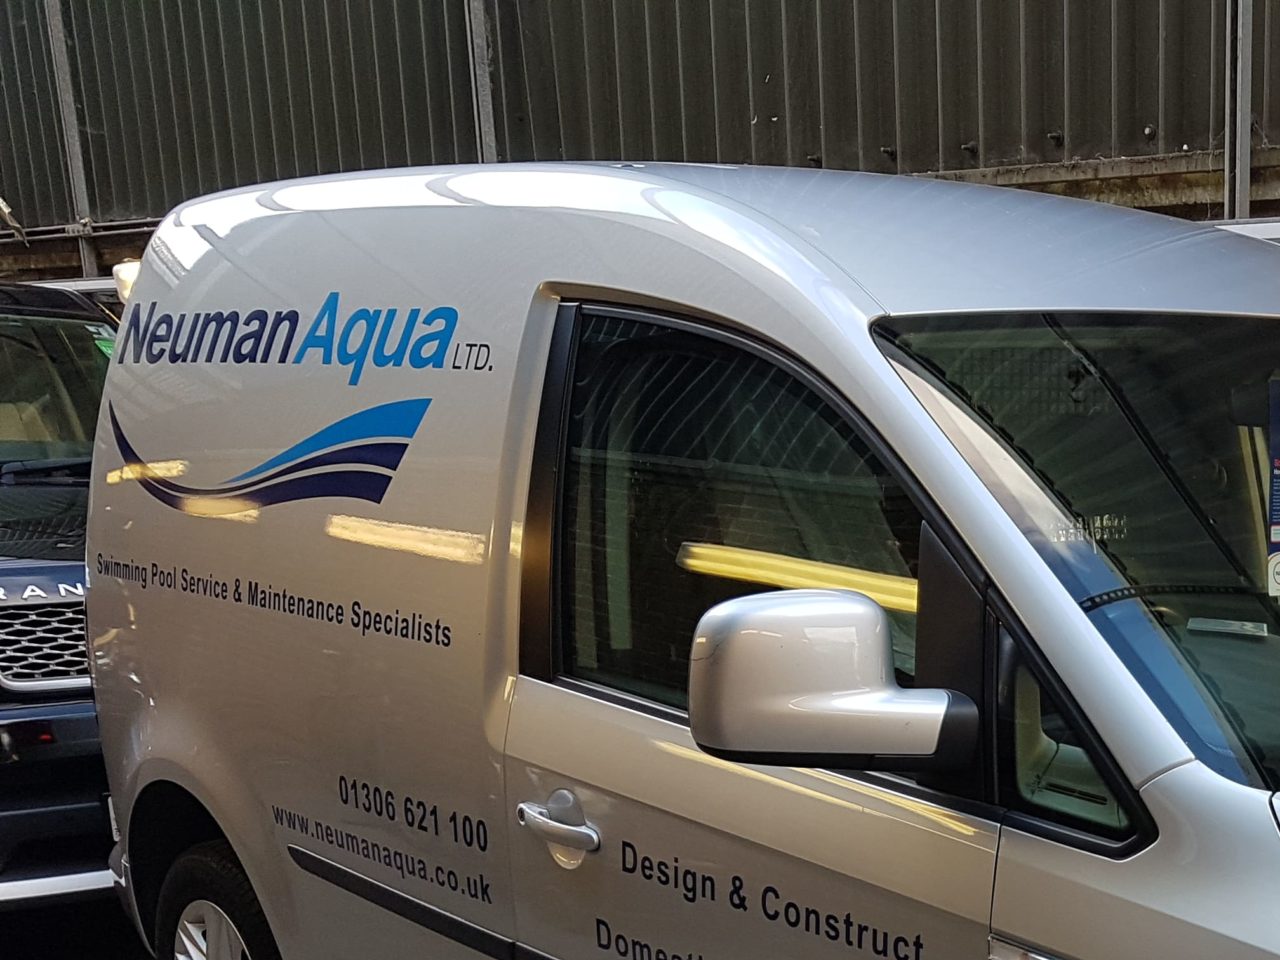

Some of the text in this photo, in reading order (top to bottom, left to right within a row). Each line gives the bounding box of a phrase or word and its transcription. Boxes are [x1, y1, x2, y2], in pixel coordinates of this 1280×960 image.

[451, 343, 494, 371] LTD.
[97, 552, 452, 647] Swimming Pool Service & Maintenance Specialists
[338, 775, 489, 853] 01306 621 100
[271, 804, 493, 905] www.neumanaqua.co.uk
[621, 840, 716, 903] Design
[728, 875, 748, 912] &
